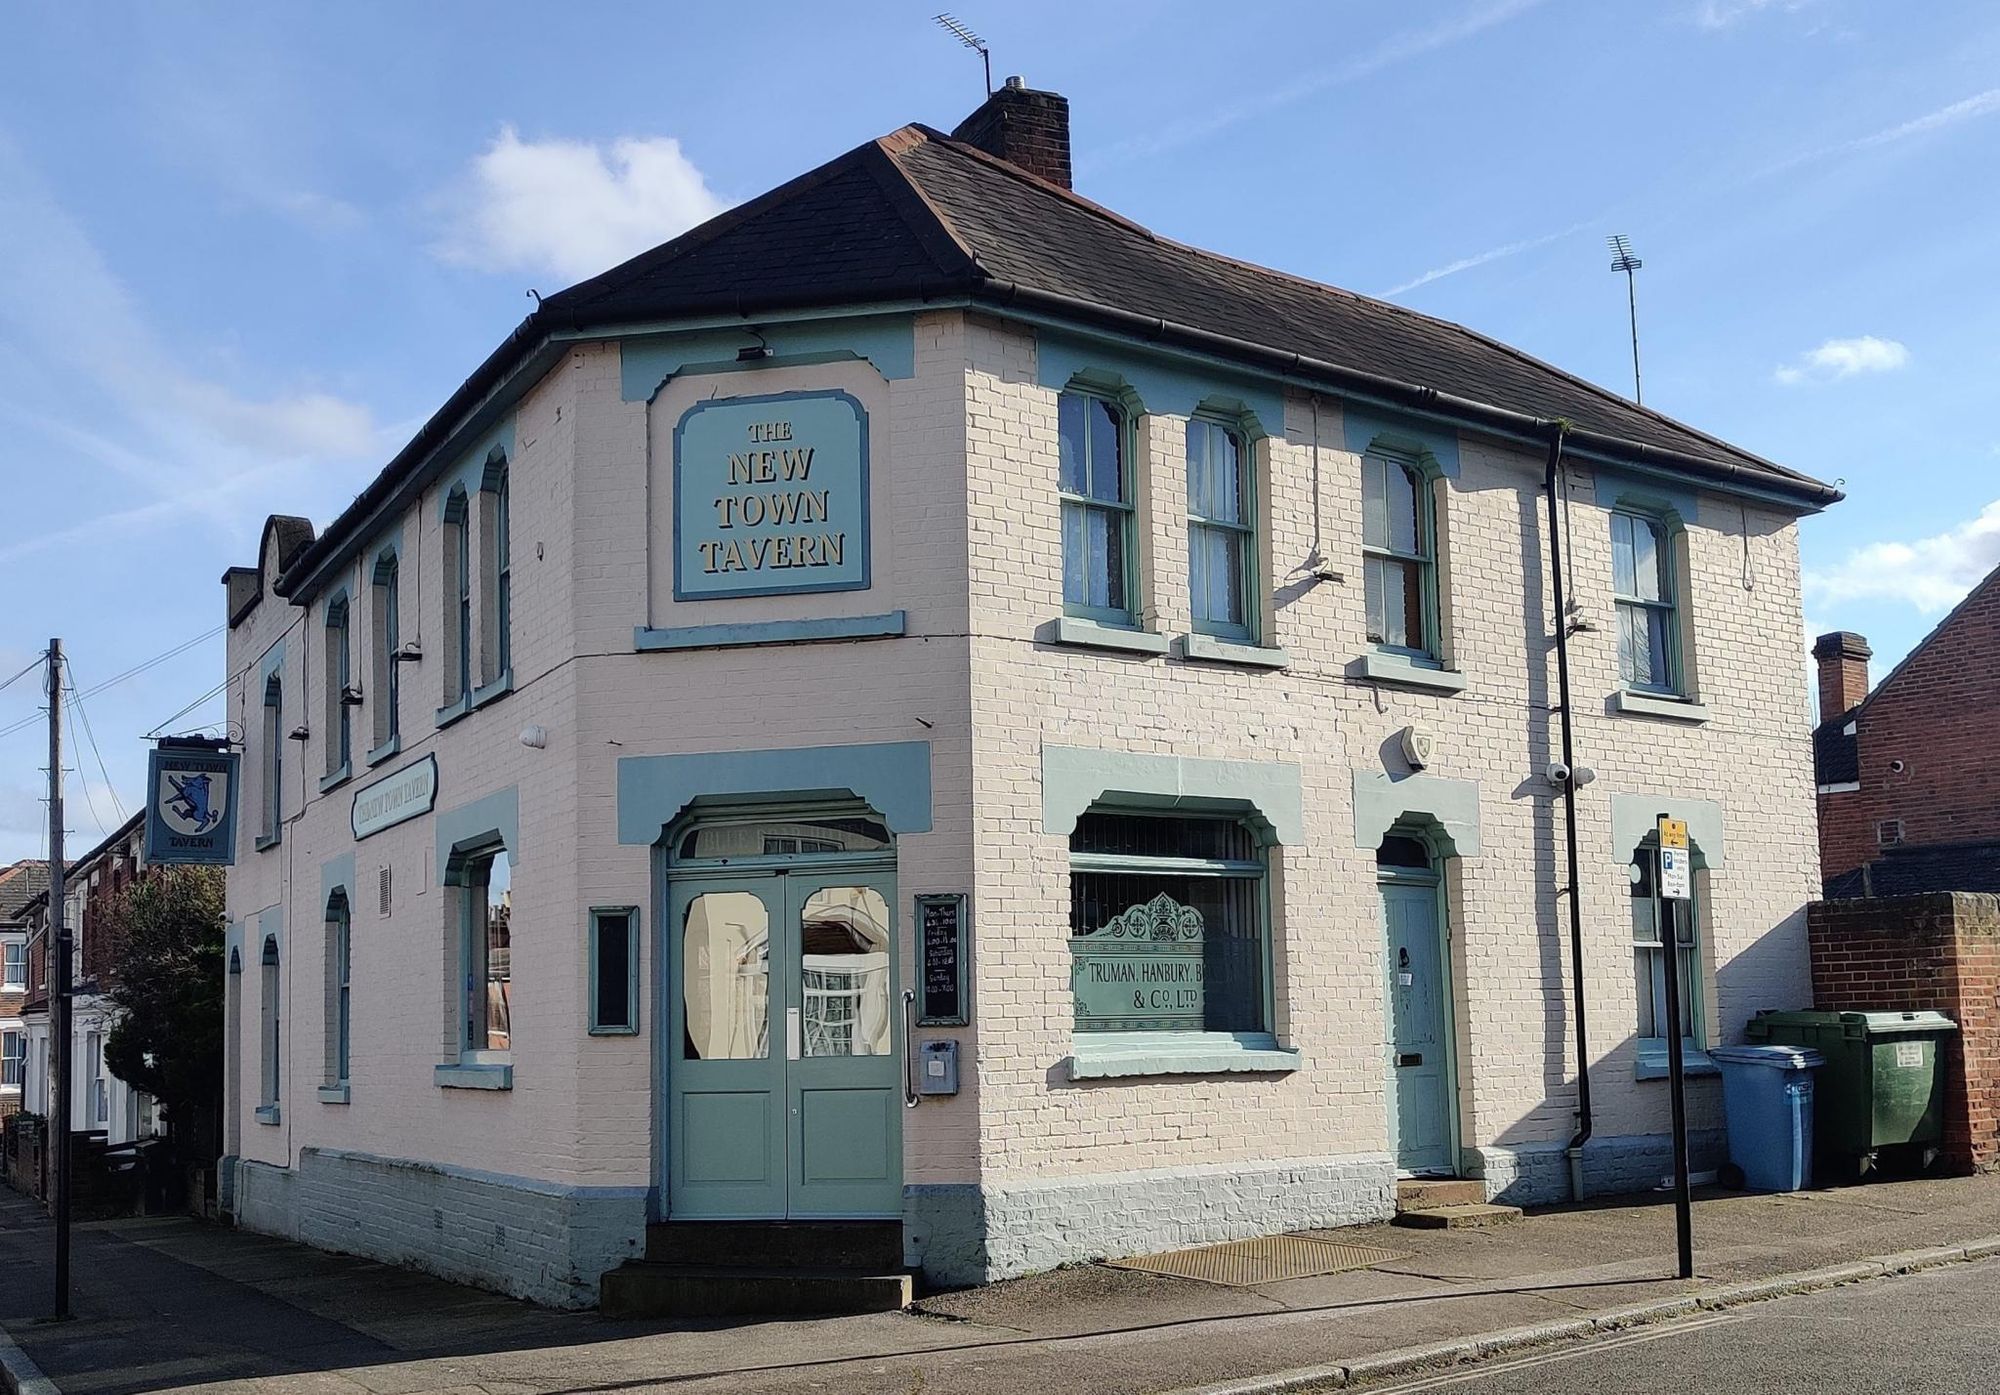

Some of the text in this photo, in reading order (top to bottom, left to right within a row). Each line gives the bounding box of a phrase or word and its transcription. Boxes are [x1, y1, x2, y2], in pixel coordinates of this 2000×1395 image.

[748, 421, 793, 442] THE
[727, 448, 815, 484] NEW
[714, 490, 830, 529] TOWN
[698, 533, 846, 573] TAVERN
[168, 837, 214, 849] TAVERN
[1133, 990, 1146, 1009] &
